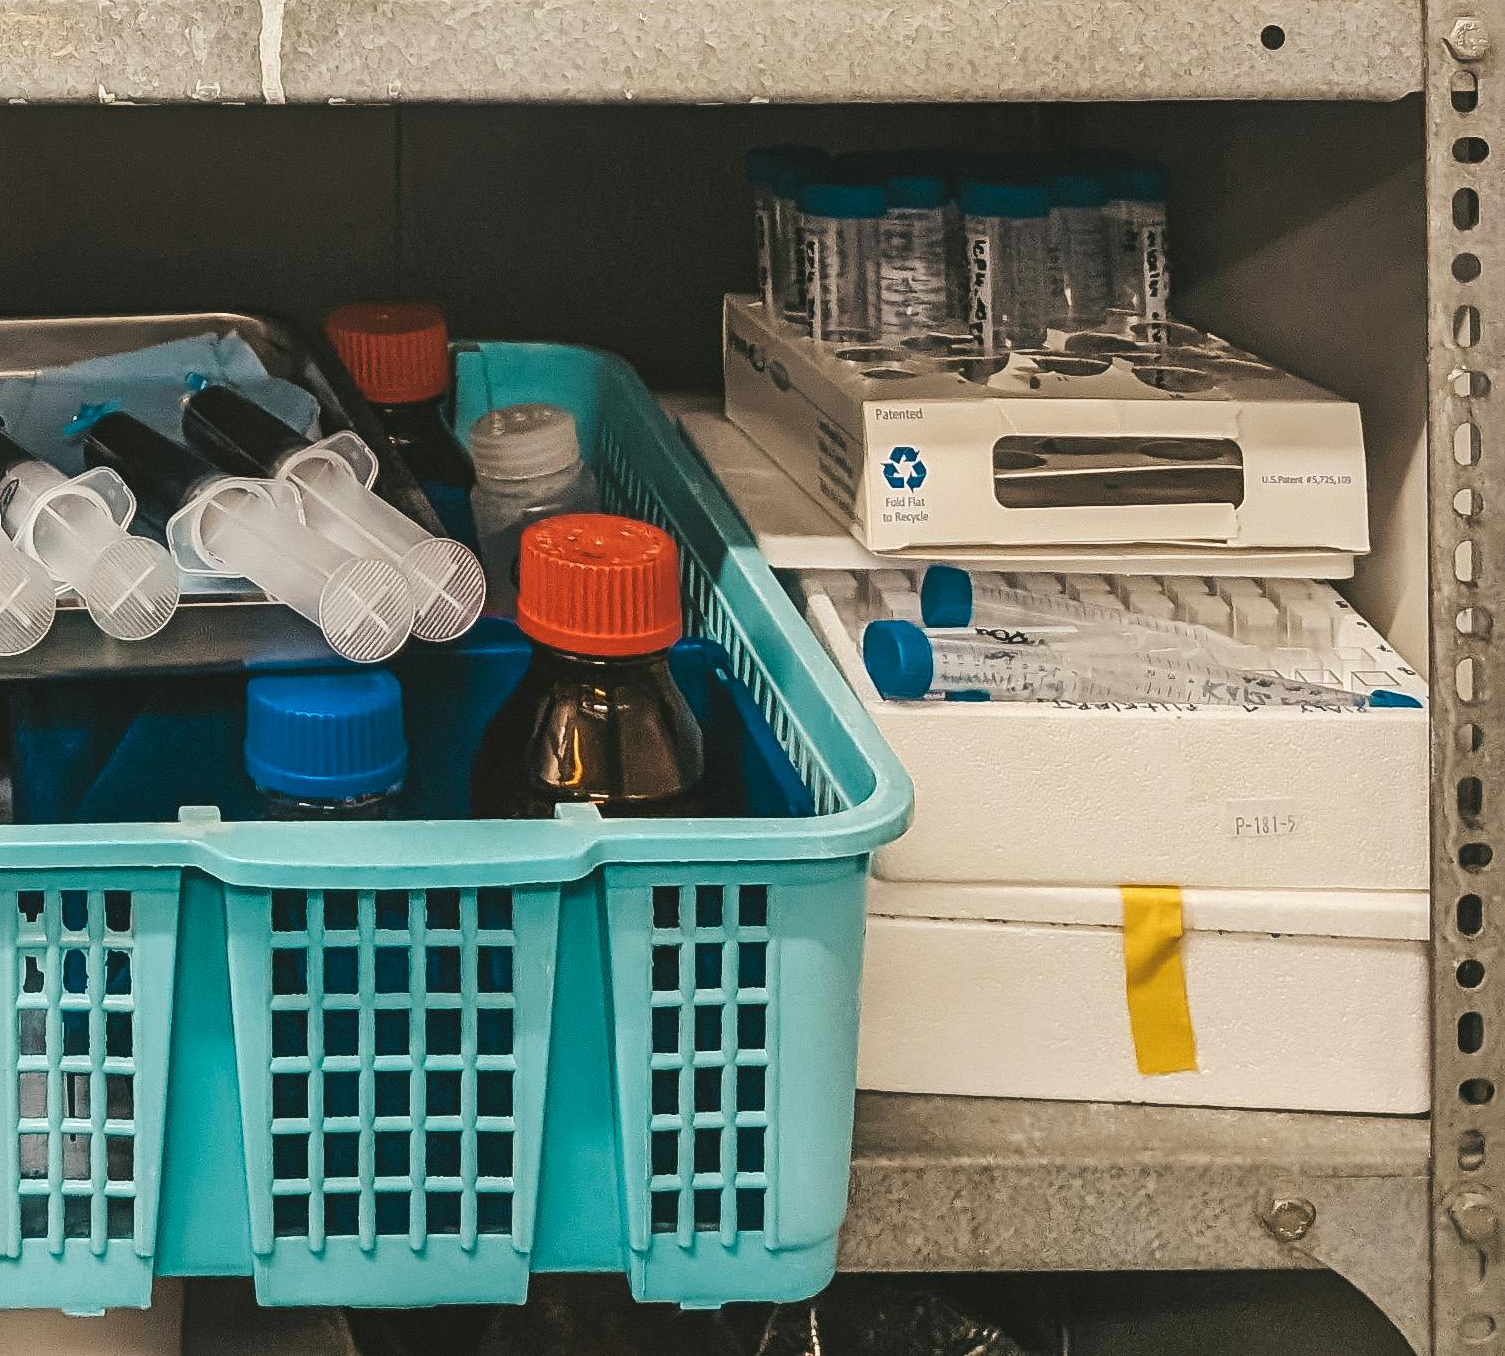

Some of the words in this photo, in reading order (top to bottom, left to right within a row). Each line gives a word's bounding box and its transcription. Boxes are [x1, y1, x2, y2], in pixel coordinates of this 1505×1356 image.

[875, 408, 924, 422] Patented
[885, 497, 905, 508] Fold
[907, 496, 926, 508] Flat
[883, 512, 893, 522] to
[894, 510, 930, 525] Recycle
